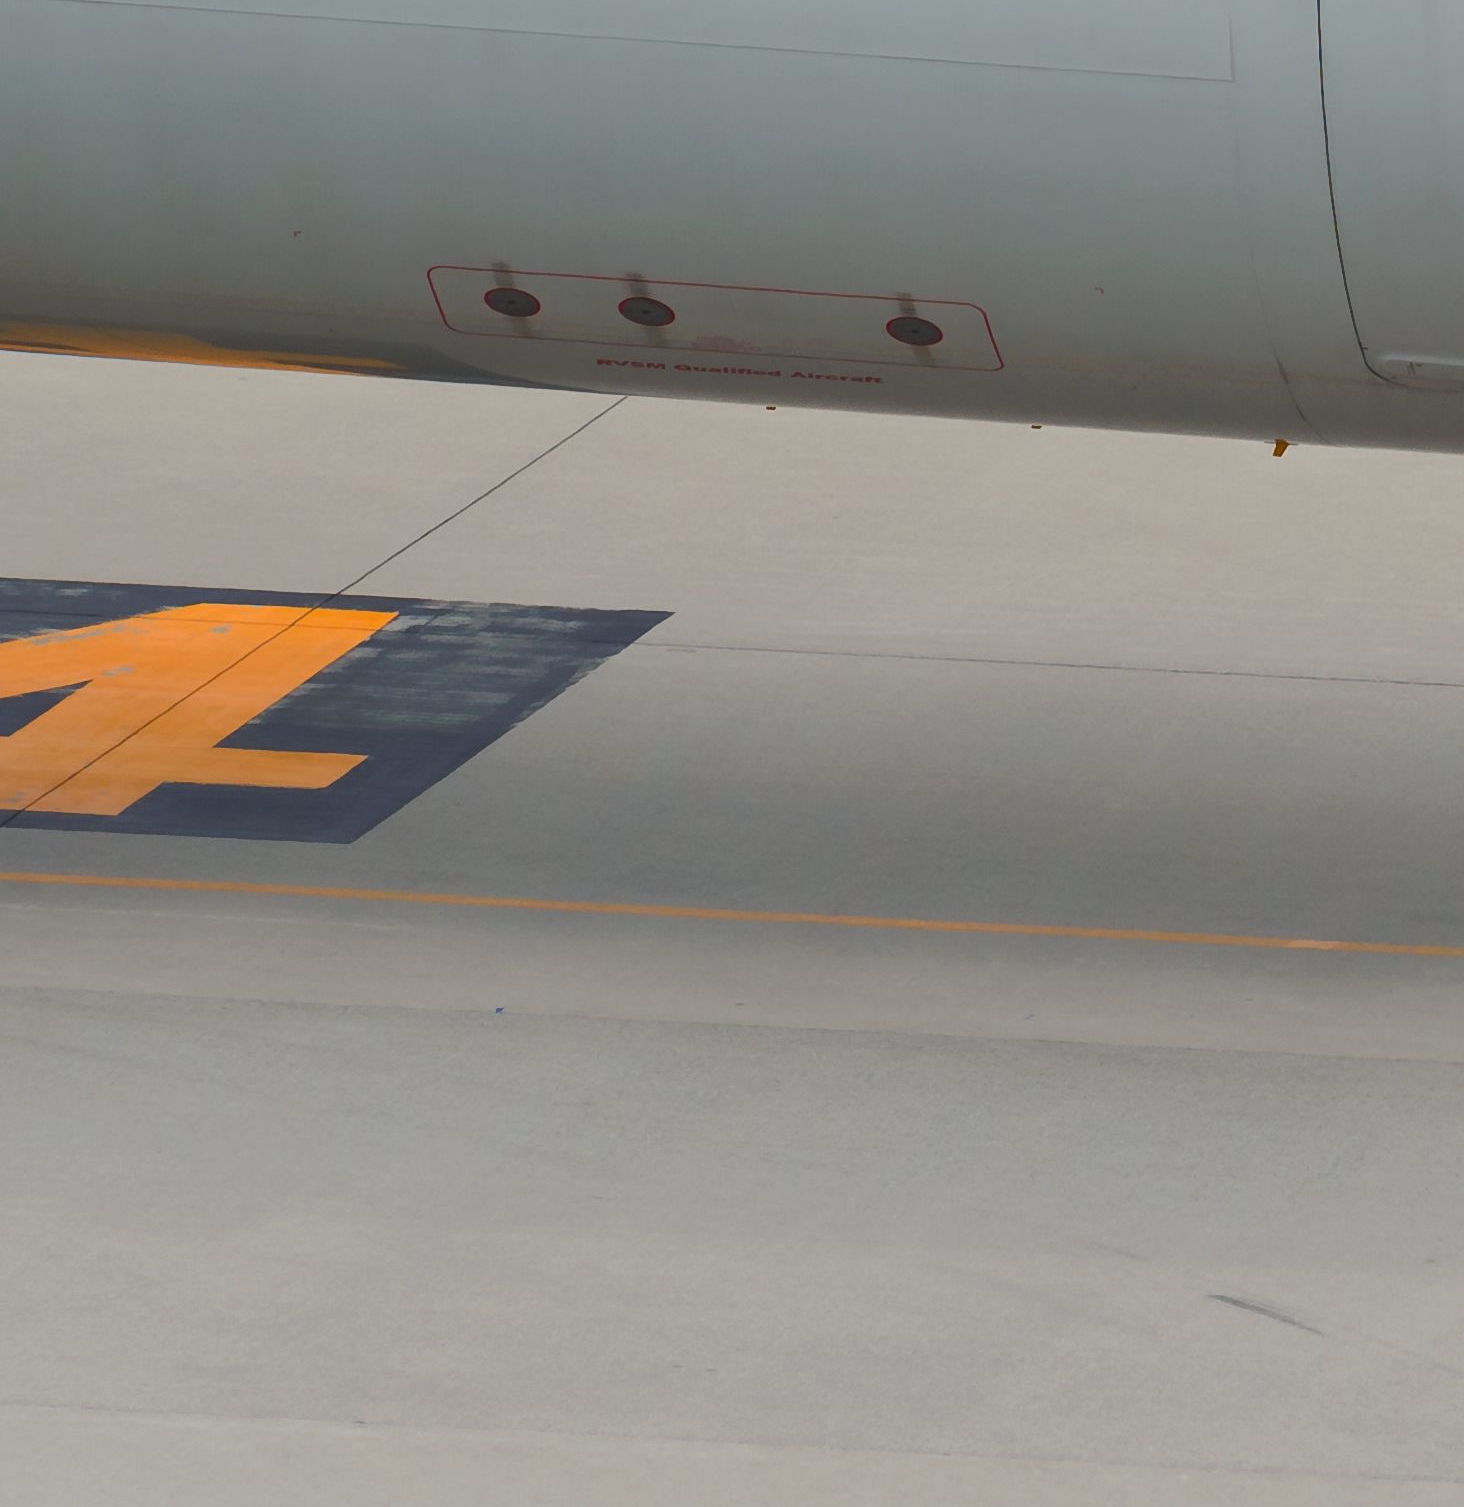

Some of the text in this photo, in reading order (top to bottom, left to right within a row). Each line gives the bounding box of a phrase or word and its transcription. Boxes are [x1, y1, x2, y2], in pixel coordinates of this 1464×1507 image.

[596, 359, 883, 384] RVSM Qualified Aircraft
